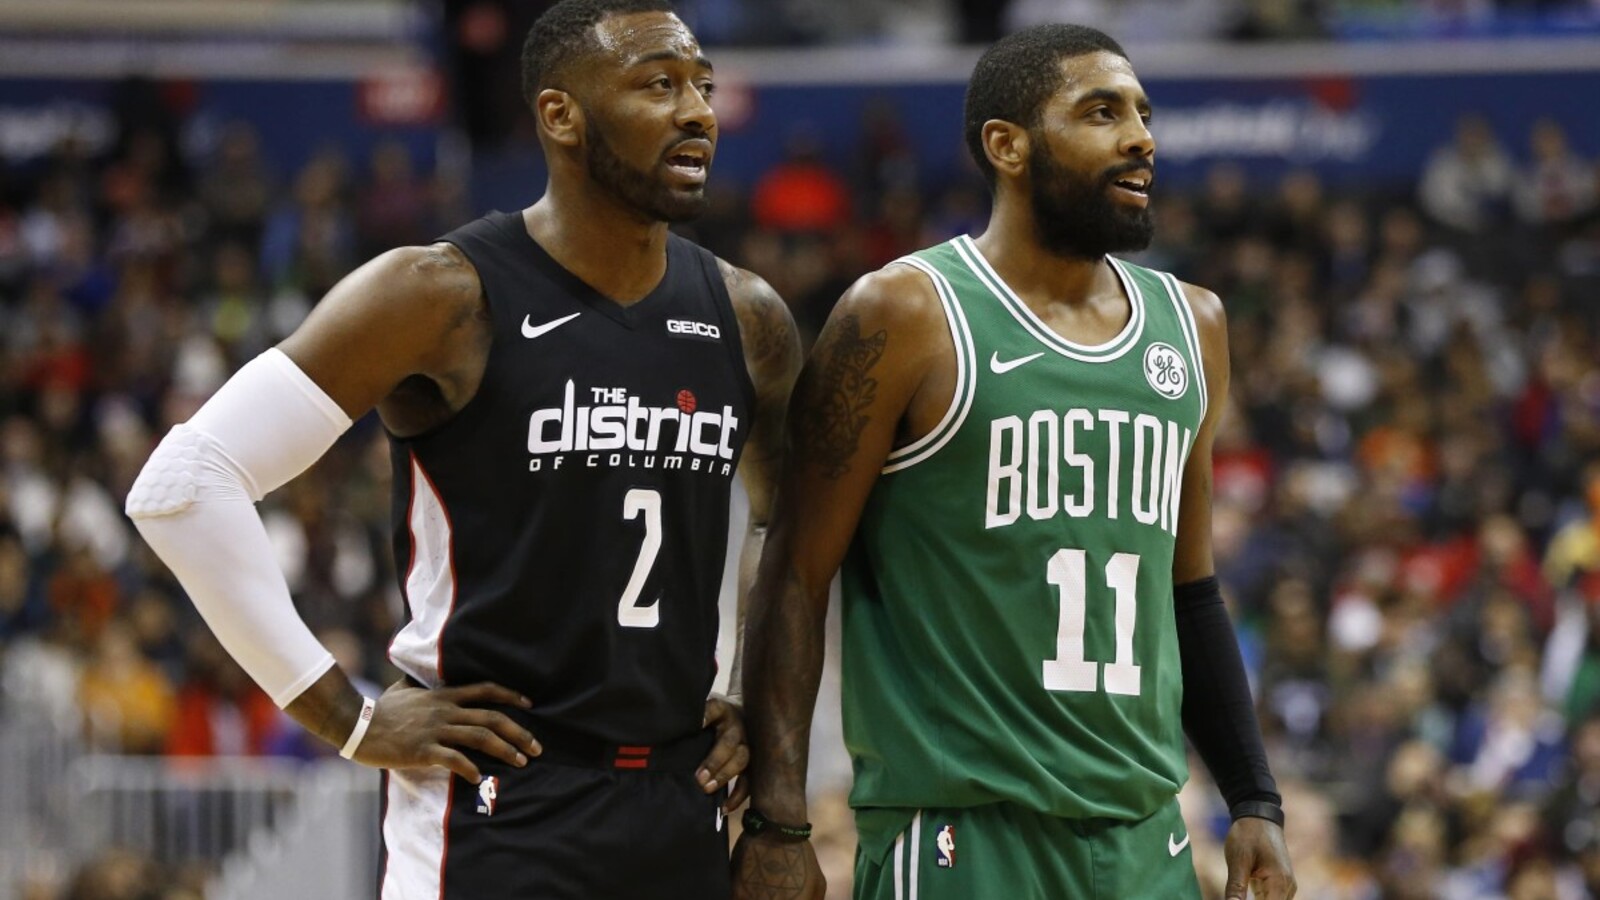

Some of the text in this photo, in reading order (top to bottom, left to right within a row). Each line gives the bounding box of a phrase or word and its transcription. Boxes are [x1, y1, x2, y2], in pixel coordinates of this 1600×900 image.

[666, 319, 720, 339] GEICO
[527, 378, 738, 460] district
[591, 387, 627, 404] THE
[529, 453, 731, 476] OF COLUMBIA
[985, 408, 1191, 538] BOSTON
[617, 488, 662, 628] 2
[1042, 548, 1141, 696] 11
